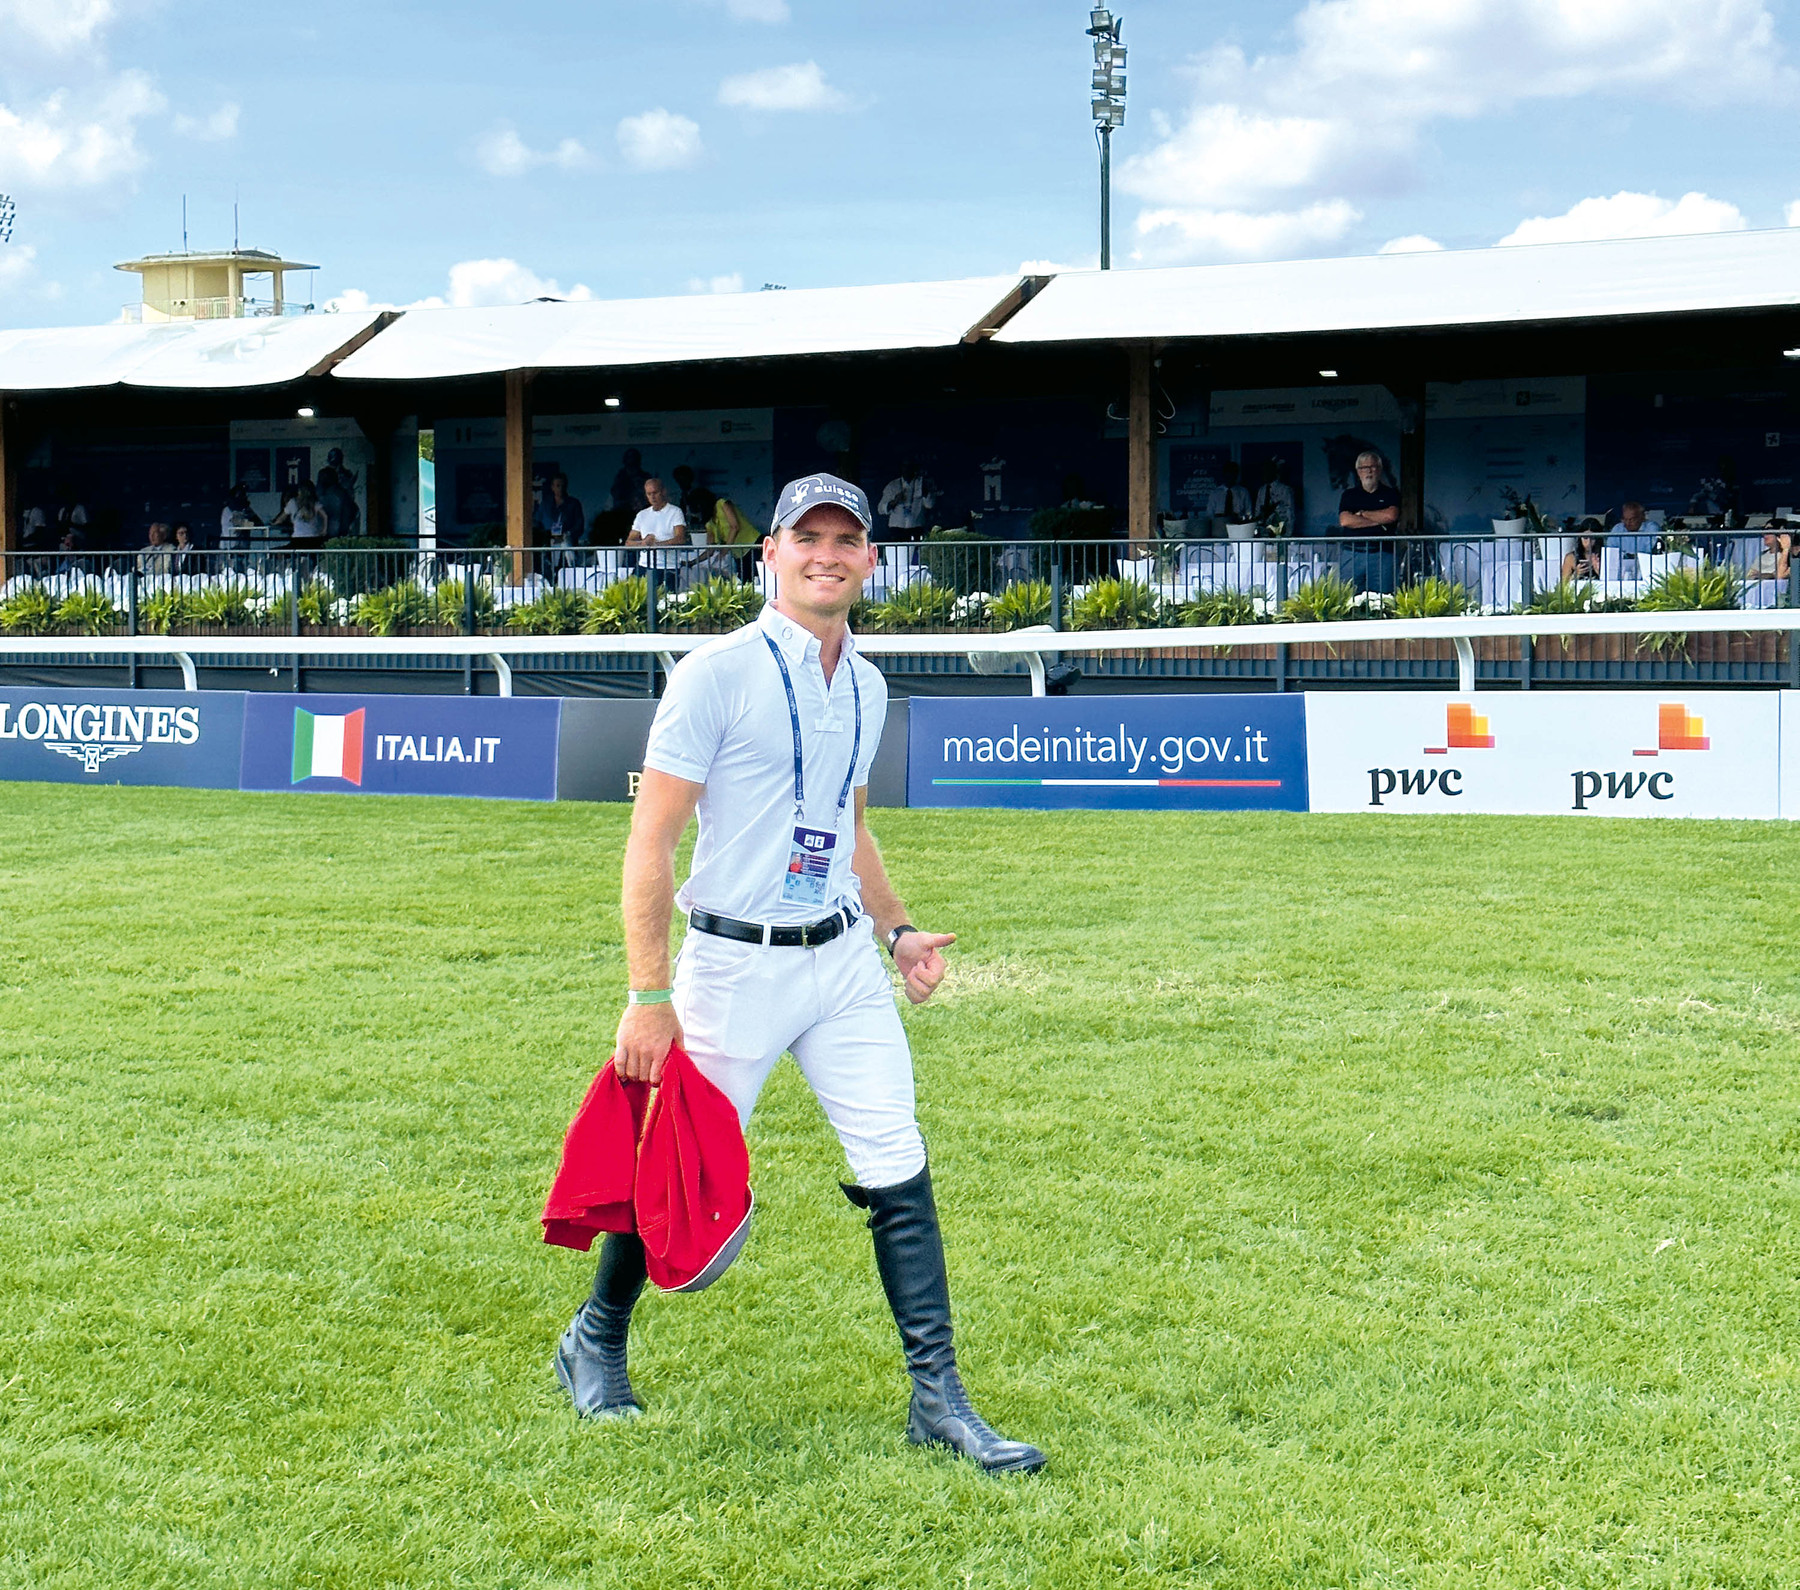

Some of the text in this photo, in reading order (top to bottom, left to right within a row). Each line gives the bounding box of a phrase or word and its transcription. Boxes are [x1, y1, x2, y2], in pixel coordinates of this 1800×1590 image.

[814, 484, 859, 503] suisse
[0, 702, 200, 745] LONGINES
[376, 734, 501, 763] ITALIA.IT
[943, 723, 1269, 773] madeinitaly.gov.it
[1367, 767, 1463, 806] pwc
[1571, 770, 1674, 810] pwc
